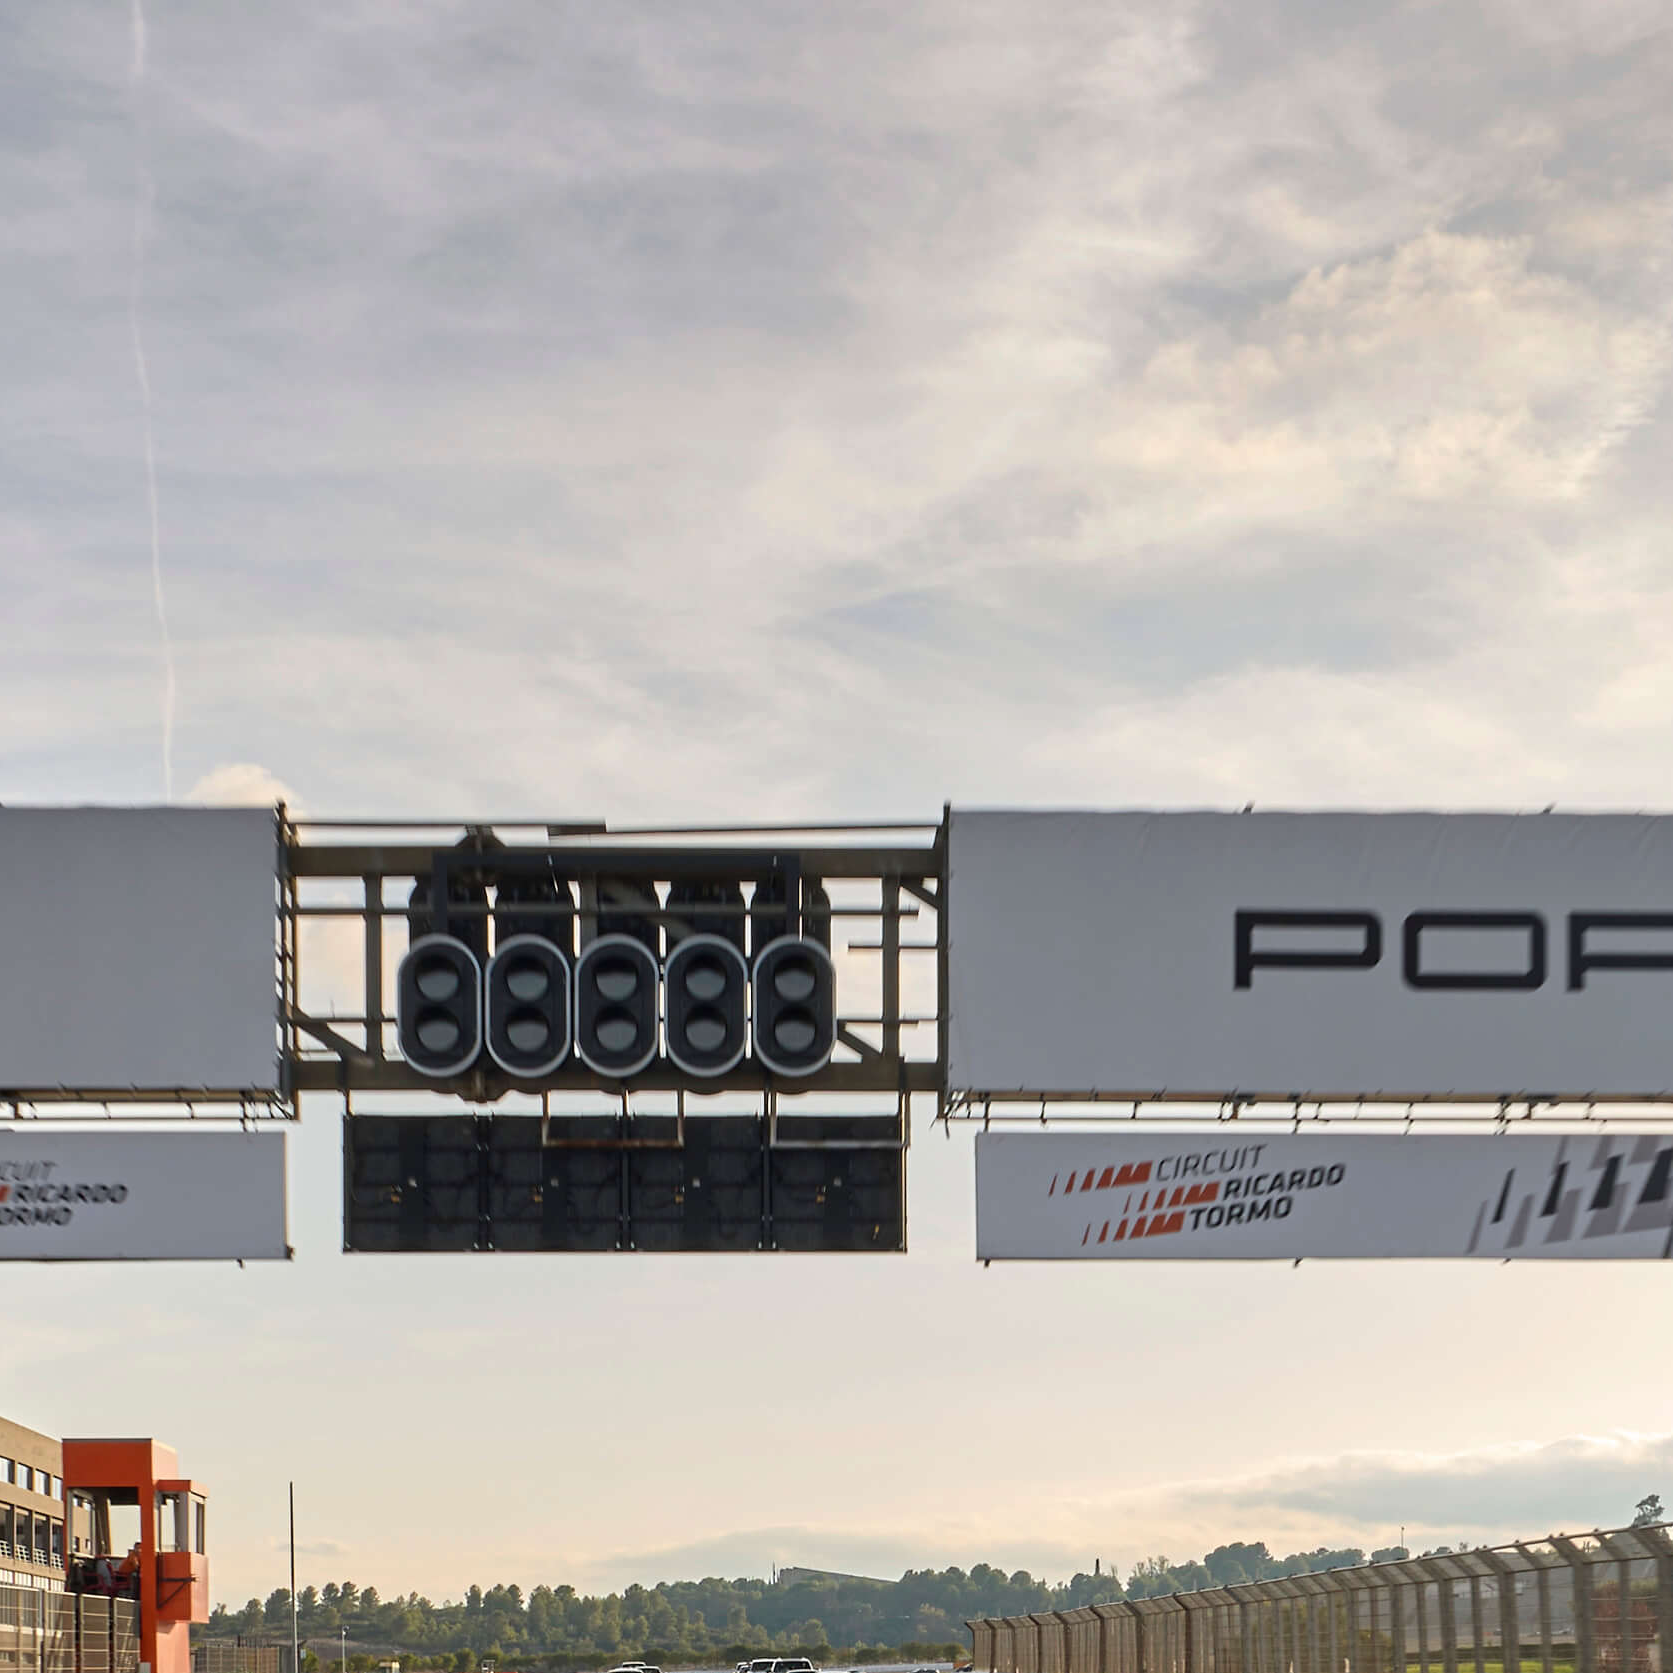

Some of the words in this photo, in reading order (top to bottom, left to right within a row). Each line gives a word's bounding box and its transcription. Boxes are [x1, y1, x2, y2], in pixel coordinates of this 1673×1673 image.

[1155, 1144, 1267, 1181] CIRCUIT
[10, 1183, 129, 1204] RICARDO
[1223, 1163, 1347, 1201] RICARDO
[1190, 1196, 1294, 1232] TORMO
